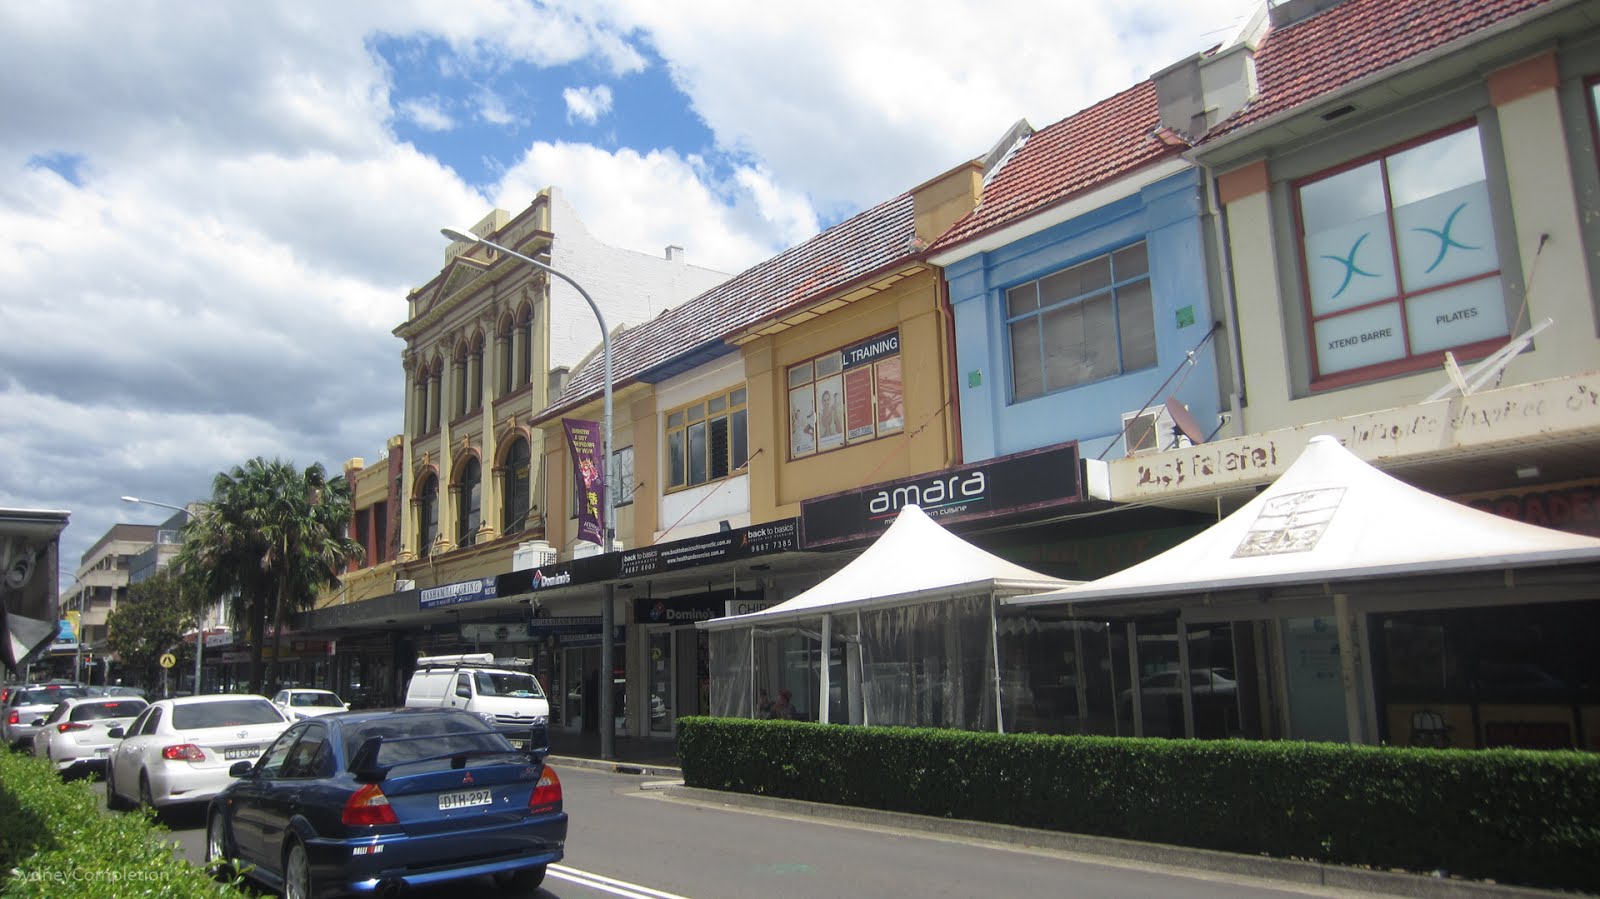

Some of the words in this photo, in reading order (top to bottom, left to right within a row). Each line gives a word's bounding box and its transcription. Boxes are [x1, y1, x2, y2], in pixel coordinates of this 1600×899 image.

[1436, 307, 1478, 325] PILATES
[1328, 336, 1359, 350] XTEND
[1360, 328, 1393, 343] BARRE
[851, 337, 898, 363] TRAINING
[869, 471, 985, 514] amara
[939, 504, 968, 516] cuisine
[747, 528, 767, 539] back
[767, 528, 774, 536] to
[774, 524, 794, 535] basics
[751, 543, 769, 552] 9687
[773, 538, 792, 549] 7385
[624, 553, 637, 562] back
[642, 550, 658, 559] basics
[541, 571, 570, 588] Domino's
[666, 607, 716, 620] Domino's
